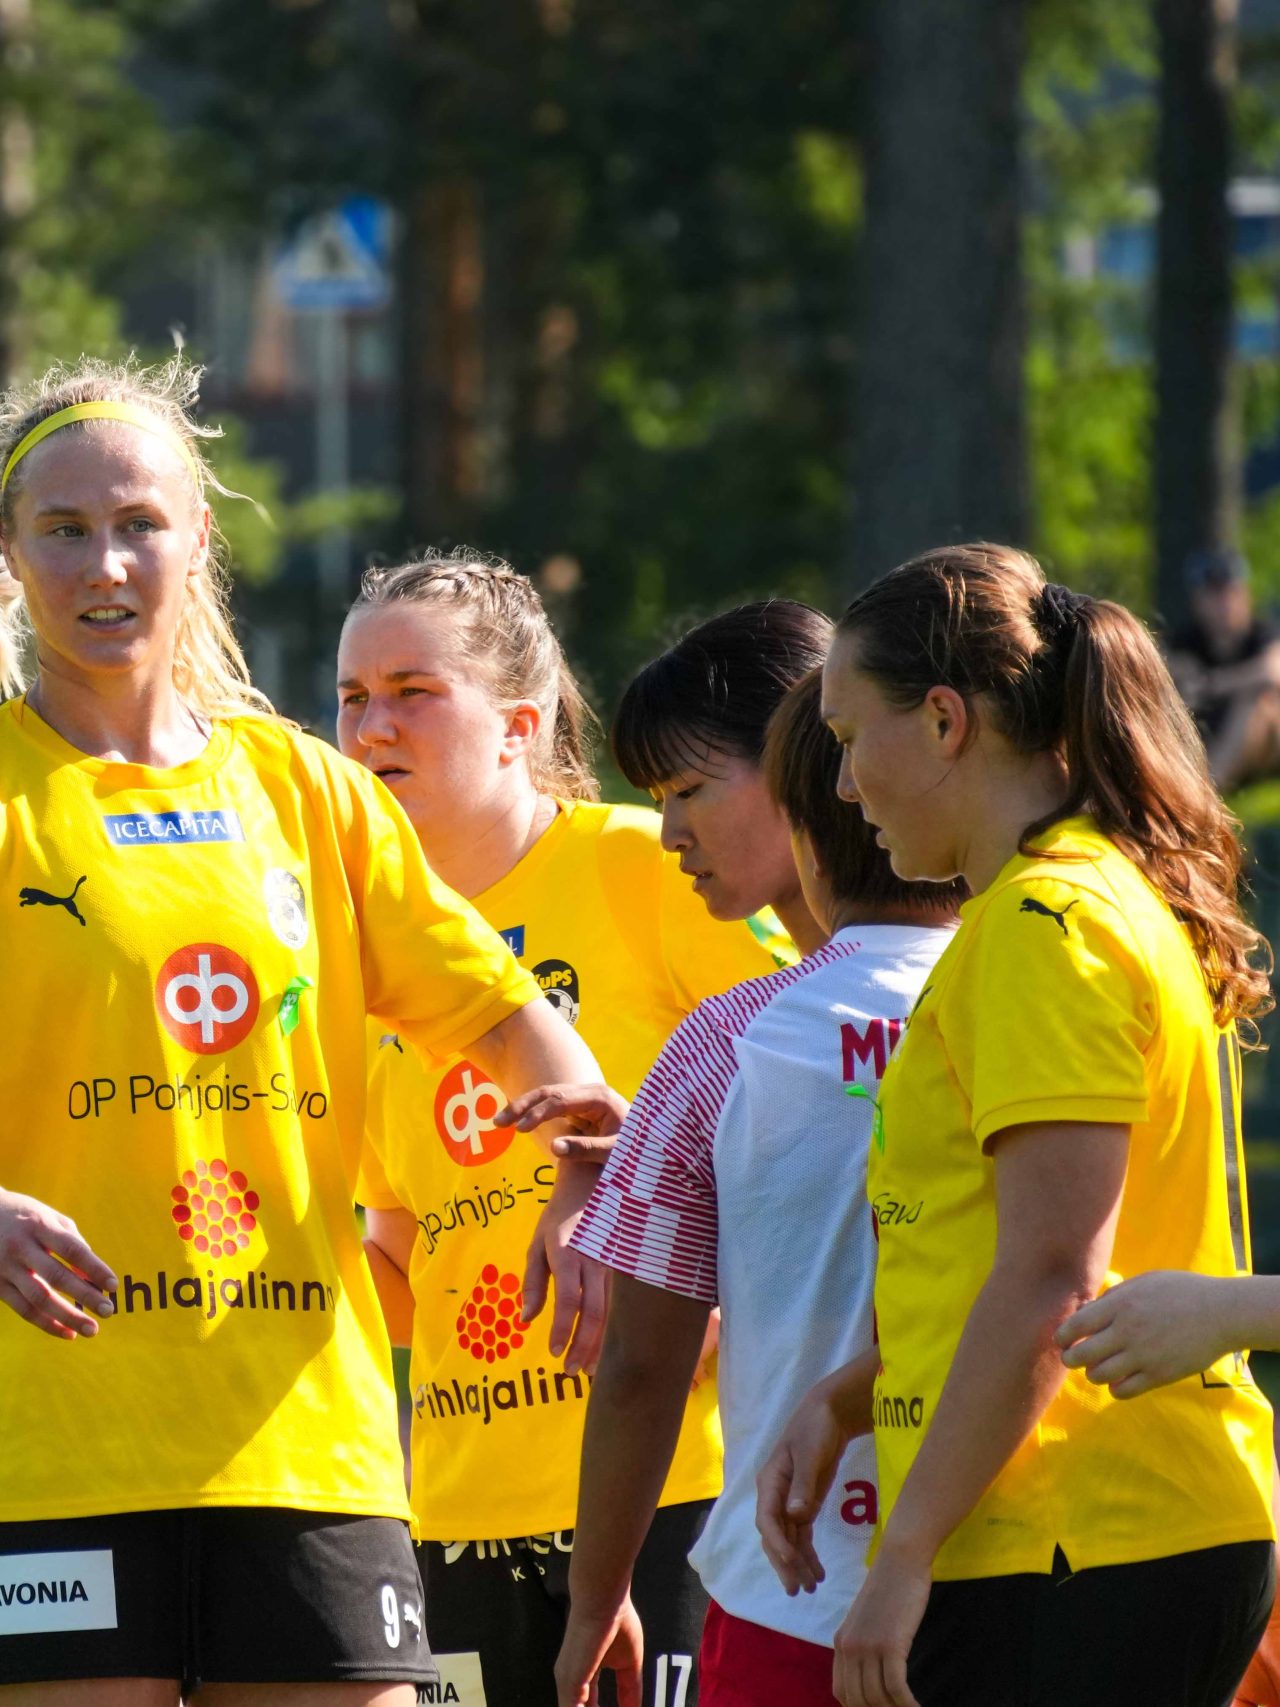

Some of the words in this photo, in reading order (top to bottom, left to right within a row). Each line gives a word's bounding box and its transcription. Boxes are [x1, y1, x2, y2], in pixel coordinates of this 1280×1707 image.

[68, 1077, 116, 1120] OP
[415, 1366, 593, 1426] Pihlajalin
[381, 1585, 400, 1649] 9
[416, 1682, 461, 1705] NIA
[654, 1653, 693, 1707] 17
